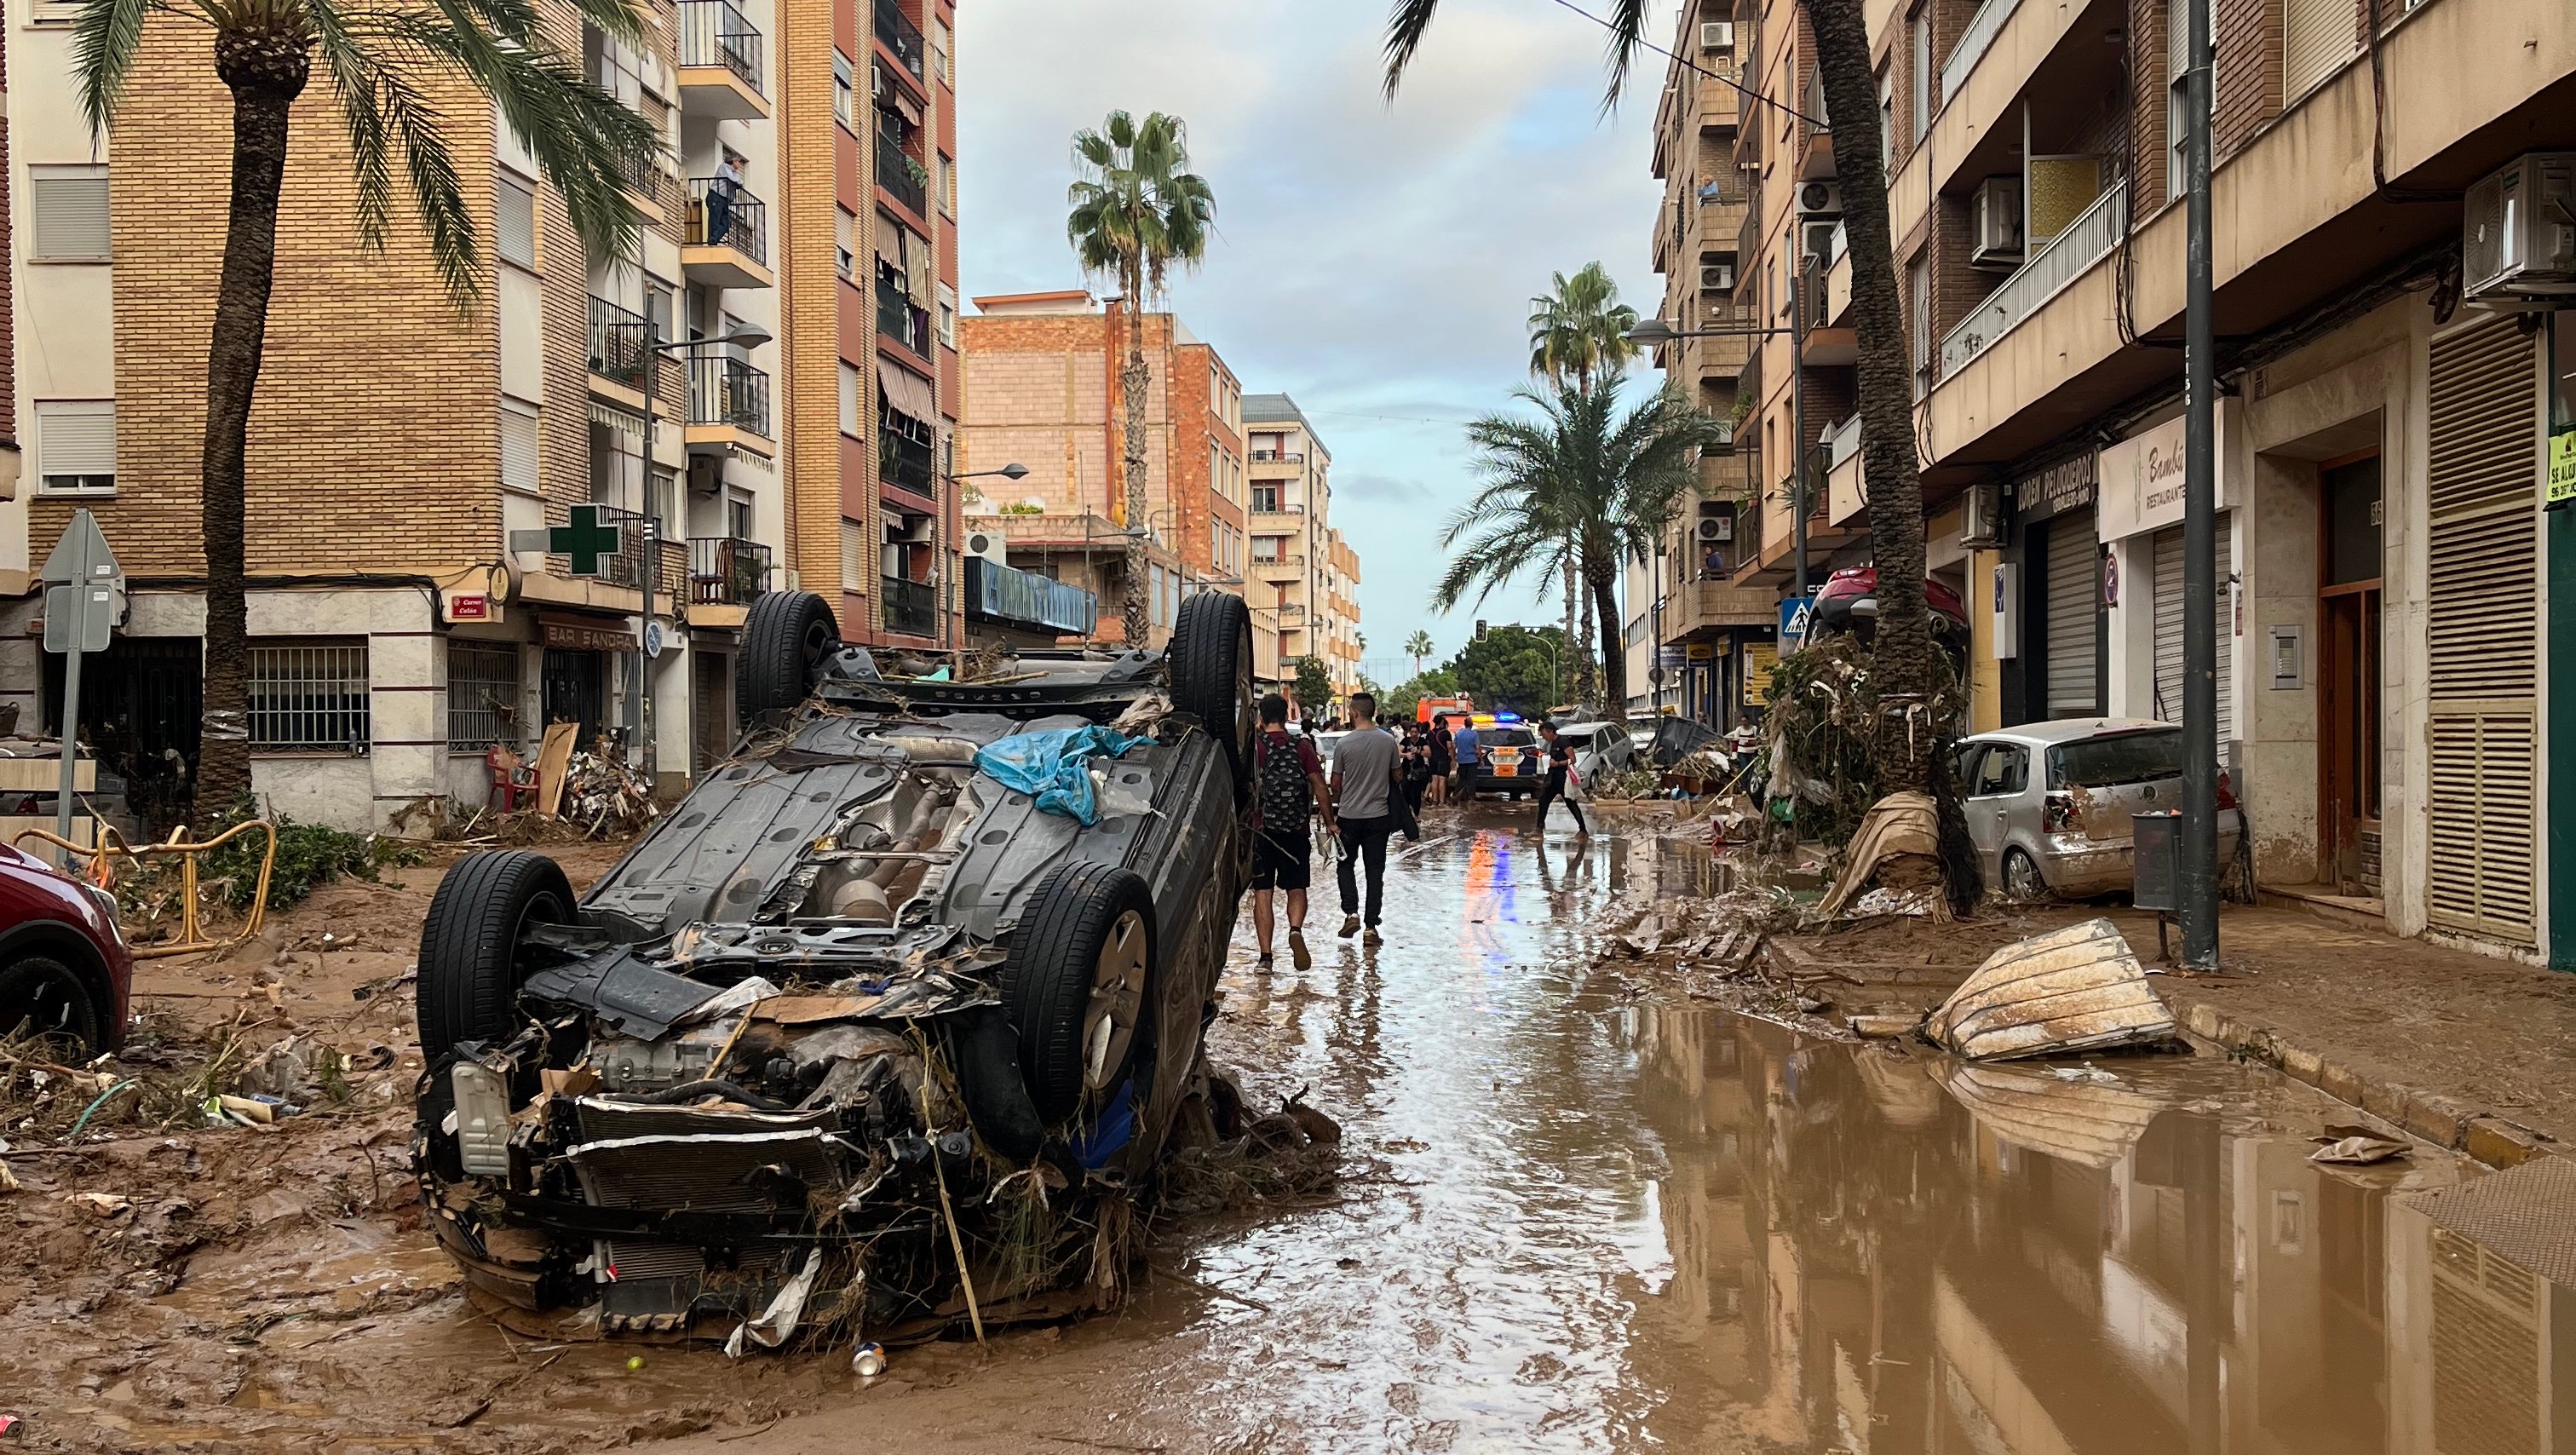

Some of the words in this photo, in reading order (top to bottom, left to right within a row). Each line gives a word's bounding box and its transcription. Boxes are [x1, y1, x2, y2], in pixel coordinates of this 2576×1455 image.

[2149, 439, 2184, 483] Bambú
[2018, 474, 2040, 512] LOREN
[2044, 452, 2092, 501] PELUQUEROS
[2551, 467, 2559, 484] SE
[2146, 483, 2186, 510] RESTAURANTE
[549, 626, 575, 643] BAR
[584, 631, 631, 648] SANDRA
